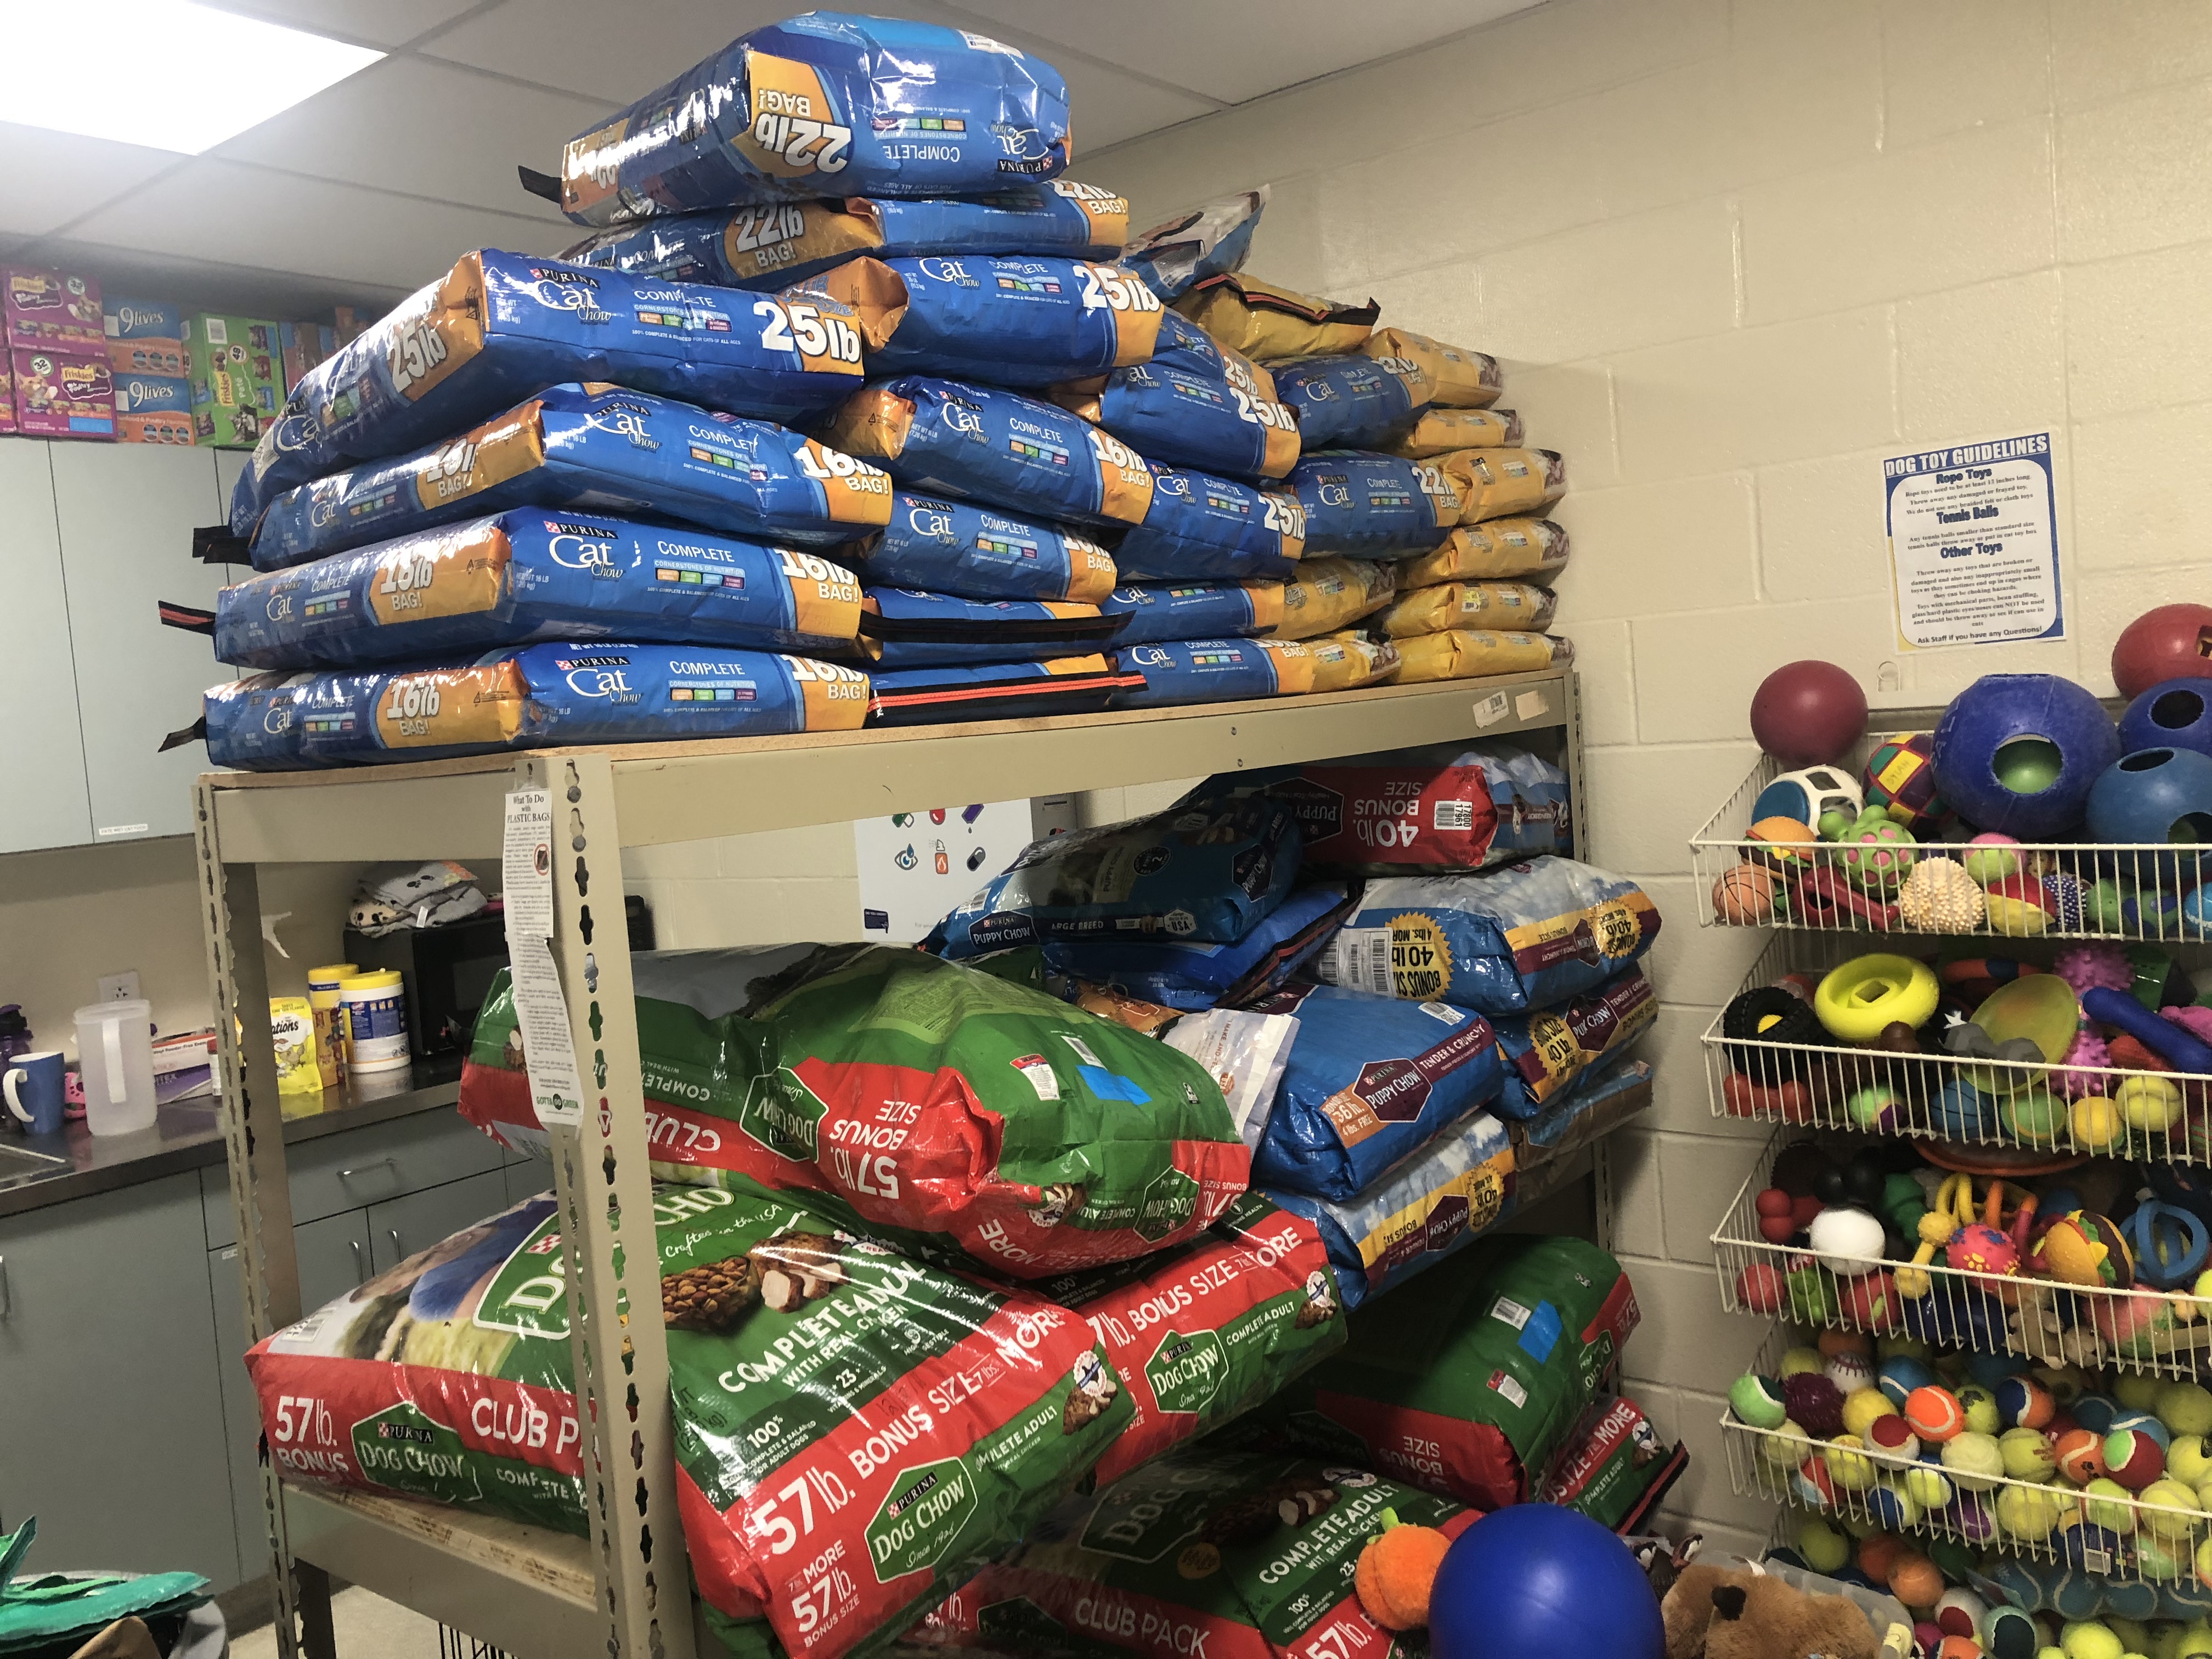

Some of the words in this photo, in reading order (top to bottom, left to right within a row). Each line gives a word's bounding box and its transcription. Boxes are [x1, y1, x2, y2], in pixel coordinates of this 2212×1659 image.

[759, 89, 811, 117] BAG!
[755, 114, 851, 173] 22lb
[882, 145, 960, 162] COMPLETE
[1000, 160, 1043, 174] PURINA
[1088, 201, 1126, 214] BAG!
[919, 257, 971, 282] Cat
[1073, 266, 1160, 312] 25lb
[753, 301, 861, 364] 25lb
[35, 359, 47, 370] 32
[64, 370, 94, 380] Friskies
[1230, 386, 1296, 432] 25lb
[1010, 417, 1063, 443] COMPLETE
[1088, 430, 1148, 473] 16lb
[1885, 457, 1916, 476] DOG
[1919, 452, 1949, 471] TOY
[1953, 435, 2048, 465] GUIDELINES
[844, 476, 889, 496] BAG!
[1120, 469, 1150, 487] BAG!
[1936, 471, 1963, 484] Rope
[1966, 468, 1992, 481] Toys
[1320, 484, 1350, 506] Cat
[1959, 490, 1985, 500] damaged
[1995, 486, 2015, 494] frayed
[914, 499, 953, 512] PURINA
[1936, 509, 1971, 524] Tennis
[1973, 505, 1999, 520] Balls
[909, 508, 952, 537] Cat
[980, 514, 1031, 537] COMPLETE
[1258, 494, 1306, 540] 25lb
[1995, 522, 2022, 531] standard
[560, 523, 617, 539] PURINA
[548, 535, 616, 569] Cat
[657, 541, 736, 563] COMPLETE
[1940, 545, 1972, 559] Other
[1976, 542, 2003, 556] Toys
[591, 562, 624, 579] Chow
[775, 548, 857, 586] 16lb
[1087, 556, 1115, 573] BAG!
[1911, 578, 1937, 586] damaged
[1976, 568, 2022, 579] inappropriately
[391, 592, 424, 611] BAG!
[817, 582, 859, 602] BAG!
[1967, 587, 1990, 595] choking
[1931, 635, 1948, 643] Staff
[2004, 625, 2042, 635] Questions!
[572, 656, 629, 668] PURINA
[1132, 646, 1171, 666] Cat
[669, 661, 745, 676] COMPLETE
[566, 668, 633, 698] Cat
[827, 683, 867, 700] BAG!
[386, 681, 440, 719] 16lb
[398, 720, 431, 736] BAG!
[514, 795, 524, 804] What
[525, 794, 533, 804] To
[534, 794, 544, 803] Do
[1384, 782, 1422, 795] SIZE
[507, 813, 531, 823] PLASTIC
[532, 812, 550, 822] BAGS
[1354, 800, 1419, 816] BONUS
[1454, 804, 1463, 826] 17961
[1463, 804, 1471, 827] 17800
[973, 929, 1002, 945] PUPPY
[1003, 927, 1031, 940] CHOW
[1172, 921, 1192, 932] USA
[1420, 1050, 1449, 1070] TENDER
[1447, 1045, 1455, 1054] &
[1453, 1024, 1486, 1049] CRUNCHY
[1365, 1084, 1397, 1109] PUPPY
[1393, 1070, 1421, 1093] CHOW
[874, 1099, 922, 1124] SIZE
[828, 1119, 909, 1151] BONUS
[756, 1204, 783, 1222] USA
[978, 1218, 1037, 1267] MORE
[1189, 1259, 1239, 1296] SIZE
[1263, 1301, 1296, 1324] ADULT
[1152, 1370, 1183, 1396] DOG
[471, 1397, 550, 1448] CLUB
[847, 1404, 935, 1480] BONUS
[926, 1364, 982, 1416] SIZE
[1593, 1402, 1637, 1444] MORE
[359, 1440, 403, 1474] DOG
[1402, 1435, 1441, 1457] SIZE
[278, 1447, 350, 1474] BONUS
[896, 1471, 938, 1511] PURINA
[872, 1520, 917, 1566] DOG
[913, 1475, 967, 1530] CHOW
[1259, 1513, 1349, 1584] COMPLETE
[801, 1539, 847, 1581] MORE
[803, 1611, 839, 1649] BONUS
[837, 1594, 861, 1622] SIZE
[1074, 1598, 1137, 1635] CLUB
